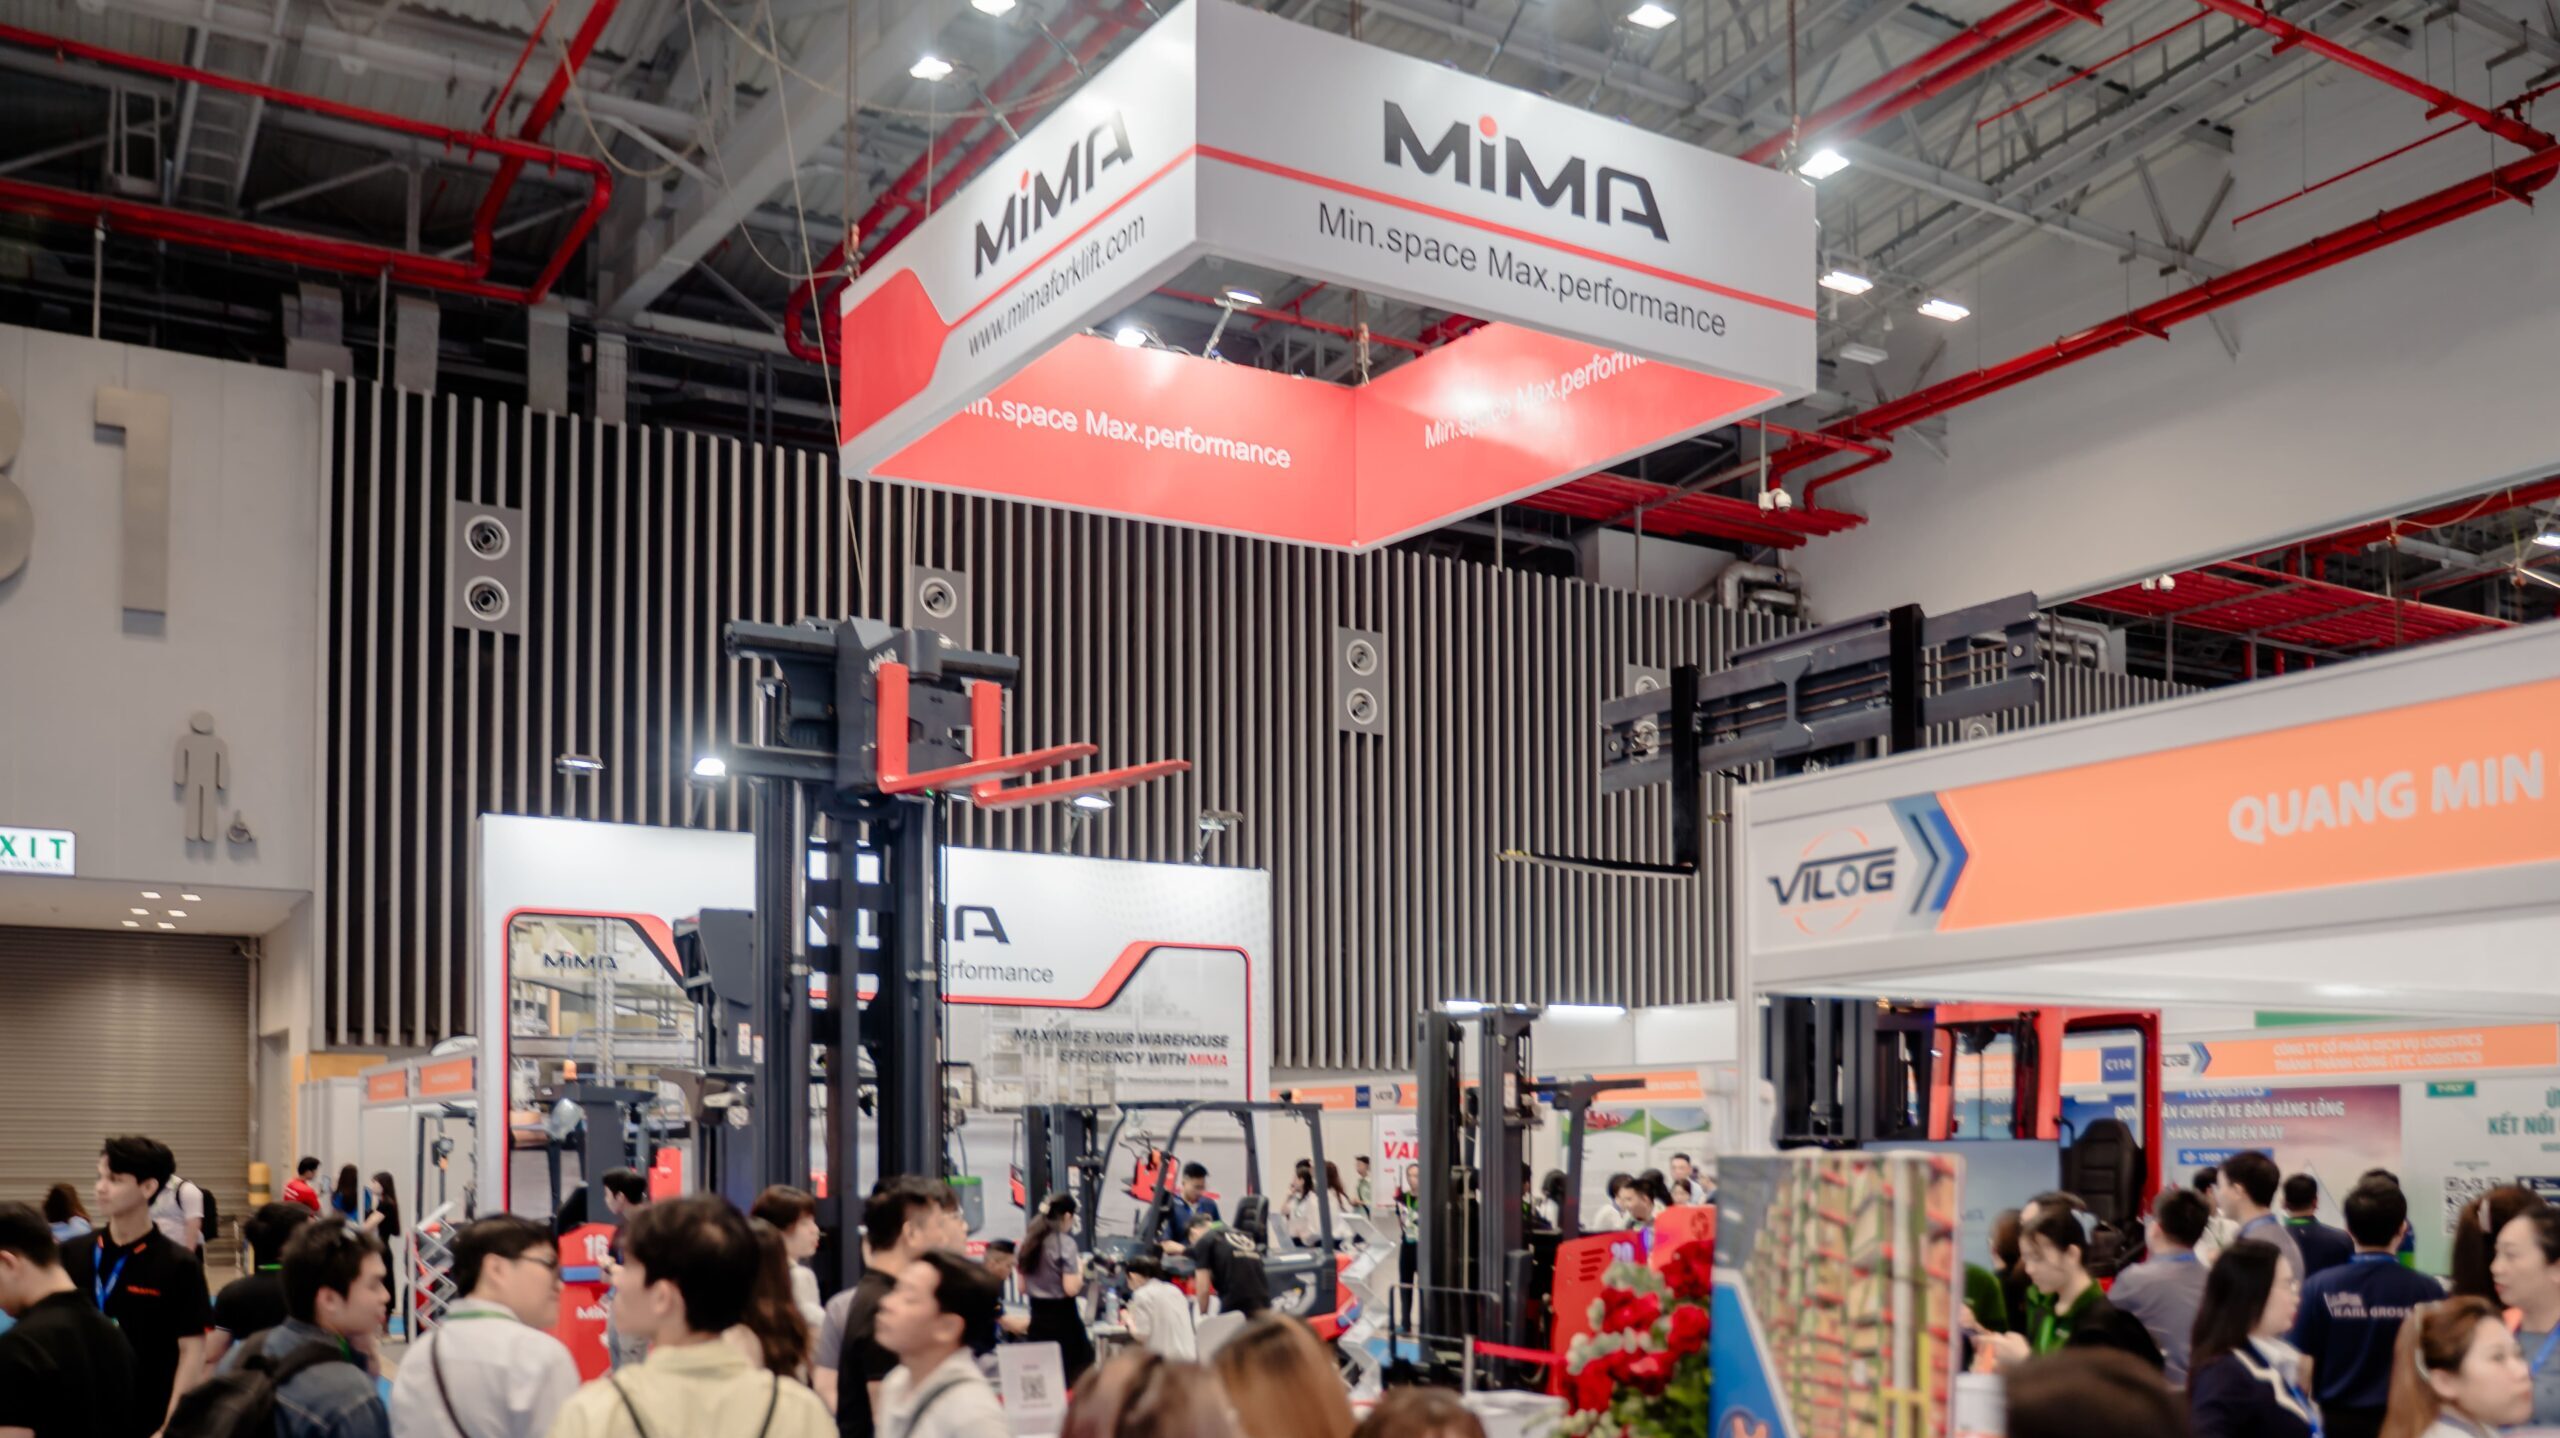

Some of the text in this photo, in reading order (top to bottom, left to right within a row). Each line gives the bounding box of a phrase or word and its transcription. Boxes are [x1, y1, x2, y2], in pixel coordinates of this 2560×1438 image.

[1383, 99, 1669, 243] MiMA
[968, 215, 1145, 357] www.mimaforklift.com
[1319, 202, 1726, 337] Min.space Max.performance
[1516, 351, 1647, 413] Max.perform
[964, 397, 1291, 469] n.space Max.performance
[2228, 748, 2544, 845] QUANG MIN
[0, 835, 67, 860] XIT
[1768, 846, 1898, 905] VILOG
[950, 960, 1054, 984] rformance
[1014, 1028, 1229, 1048] MAXIMIZE YOUR WAREHOUSE
[1059, 1051, 1143, 1065] EFFICIENCY
[1148, 1053, 1187, 1066] WITH
[2421, 1033, 2484, 1049] LOGISTICS
